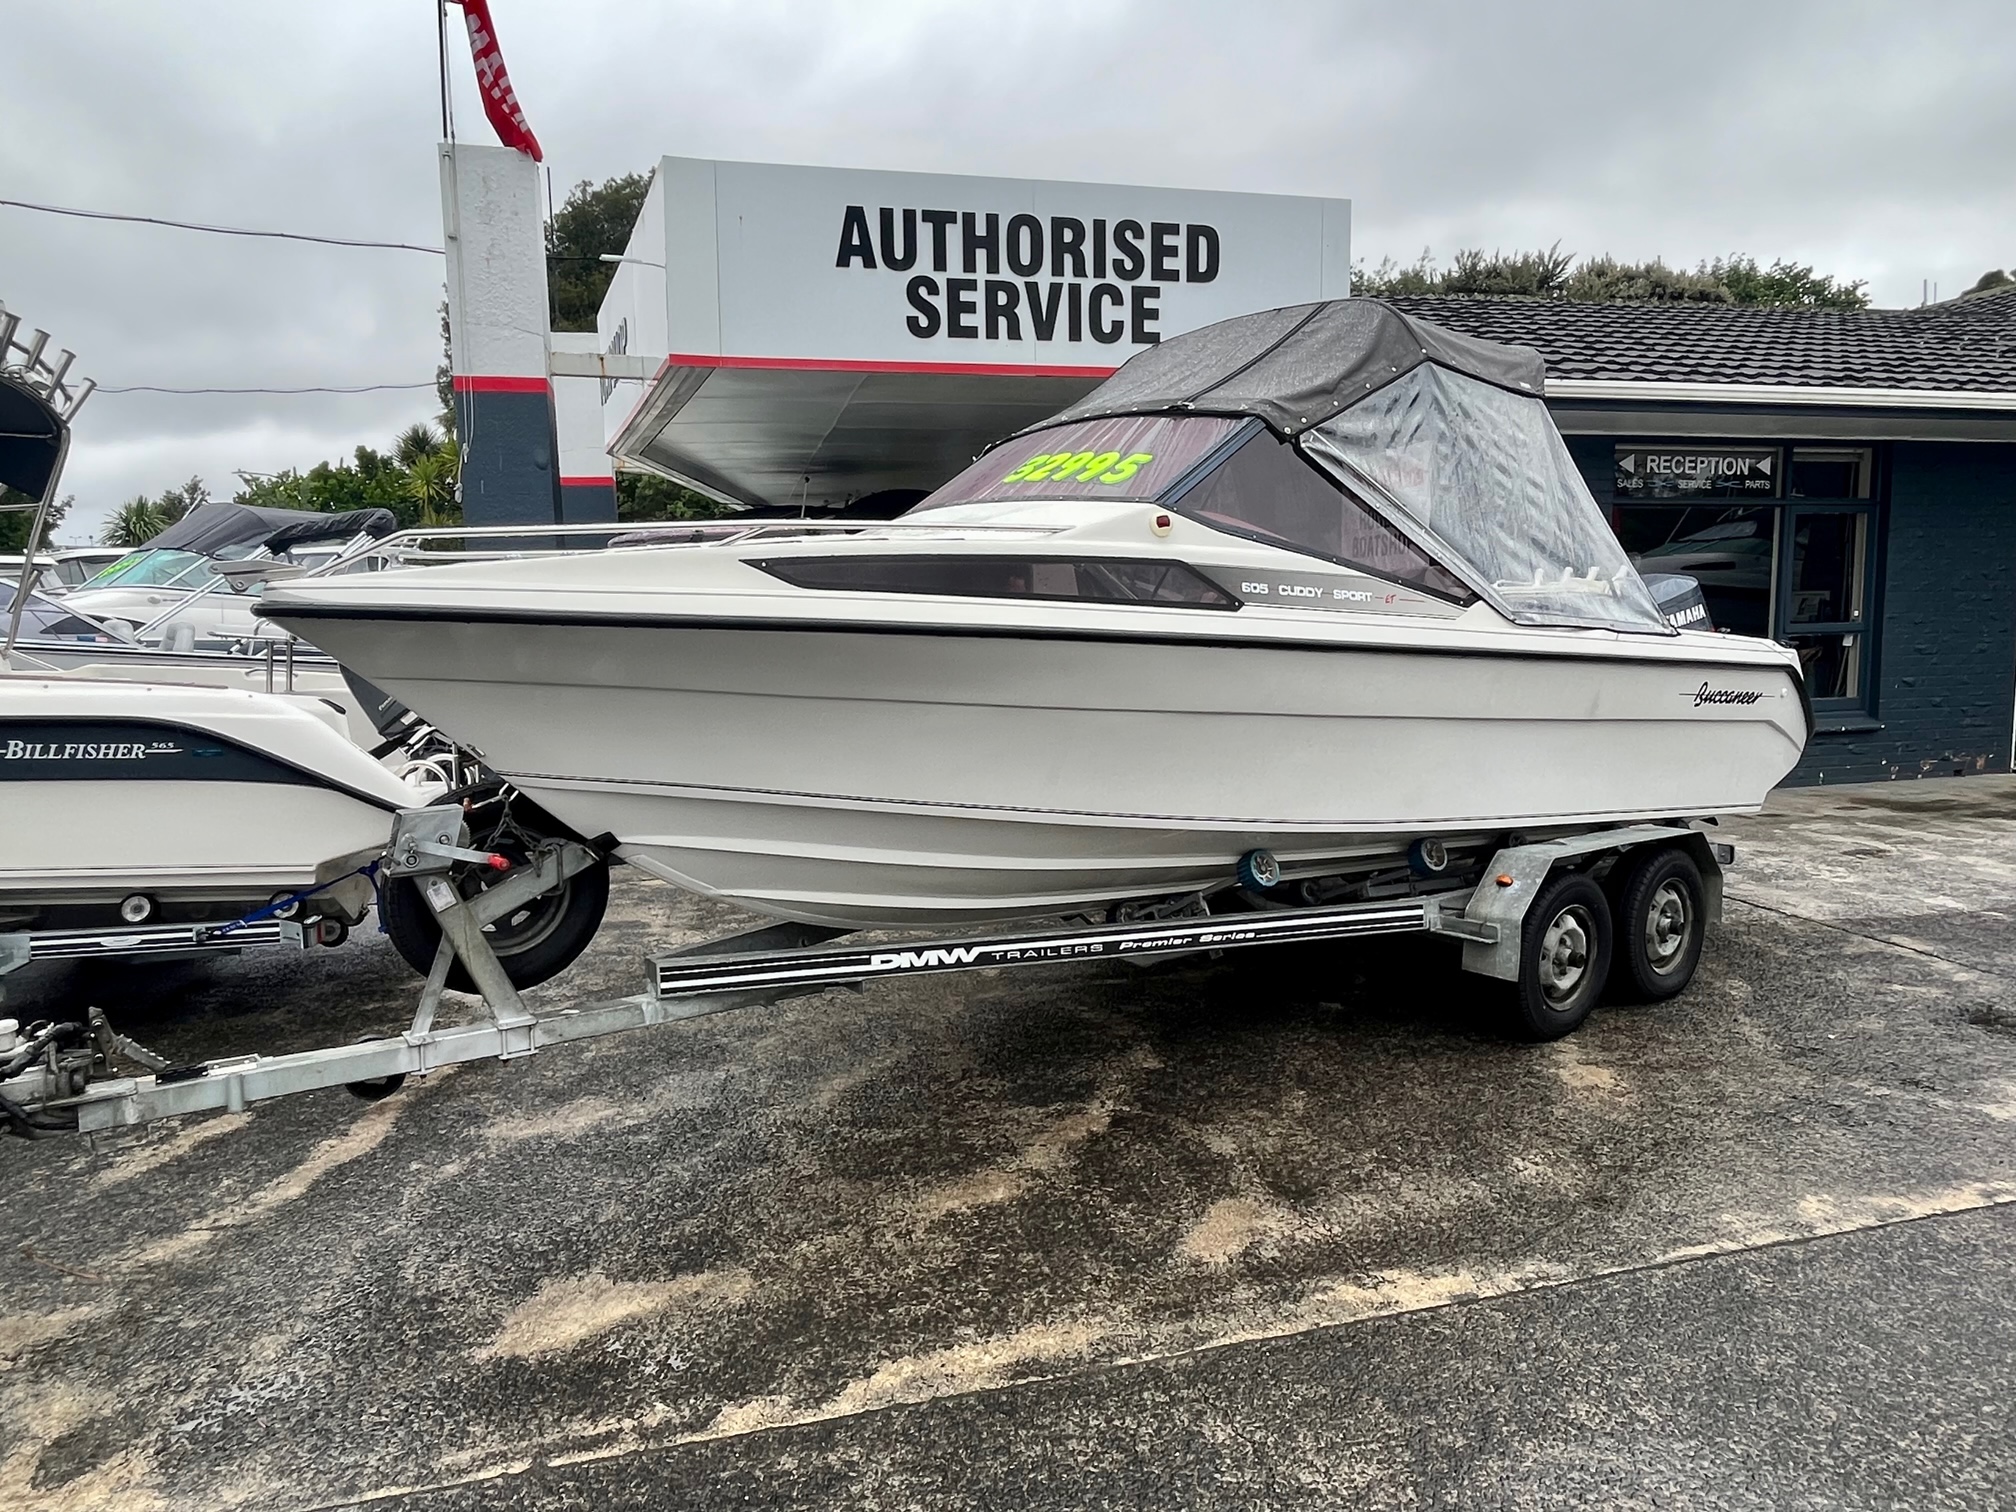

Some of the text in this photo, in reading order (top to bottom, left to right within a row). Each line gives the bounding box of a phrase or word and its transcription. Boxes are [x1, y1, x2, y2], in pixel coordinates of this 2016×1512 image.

[835, 205, 1220, 284] AUTHORISED
[906, 275, 1161, 344] SERVICE
[1003, 451, 1153, 485] 32995
[1646, 455, 1750, 476] RECEPTION
[1617, 478, 1771, 490] SALES SERVICE PARTS
[1241, 582, 1269, 594] 605
[1278, 584, 1323, 598] CUDDY
[1333, 589, 1373, 602] SPORT
[1665, 603, 1707, 628] AMAHA
[1694, 681, 1763, 708] Buccaneer
[4, 740, 146, 760] BILLFISHER
[871, 932, 1255, 968] DMW TRAILERS Premier Series
